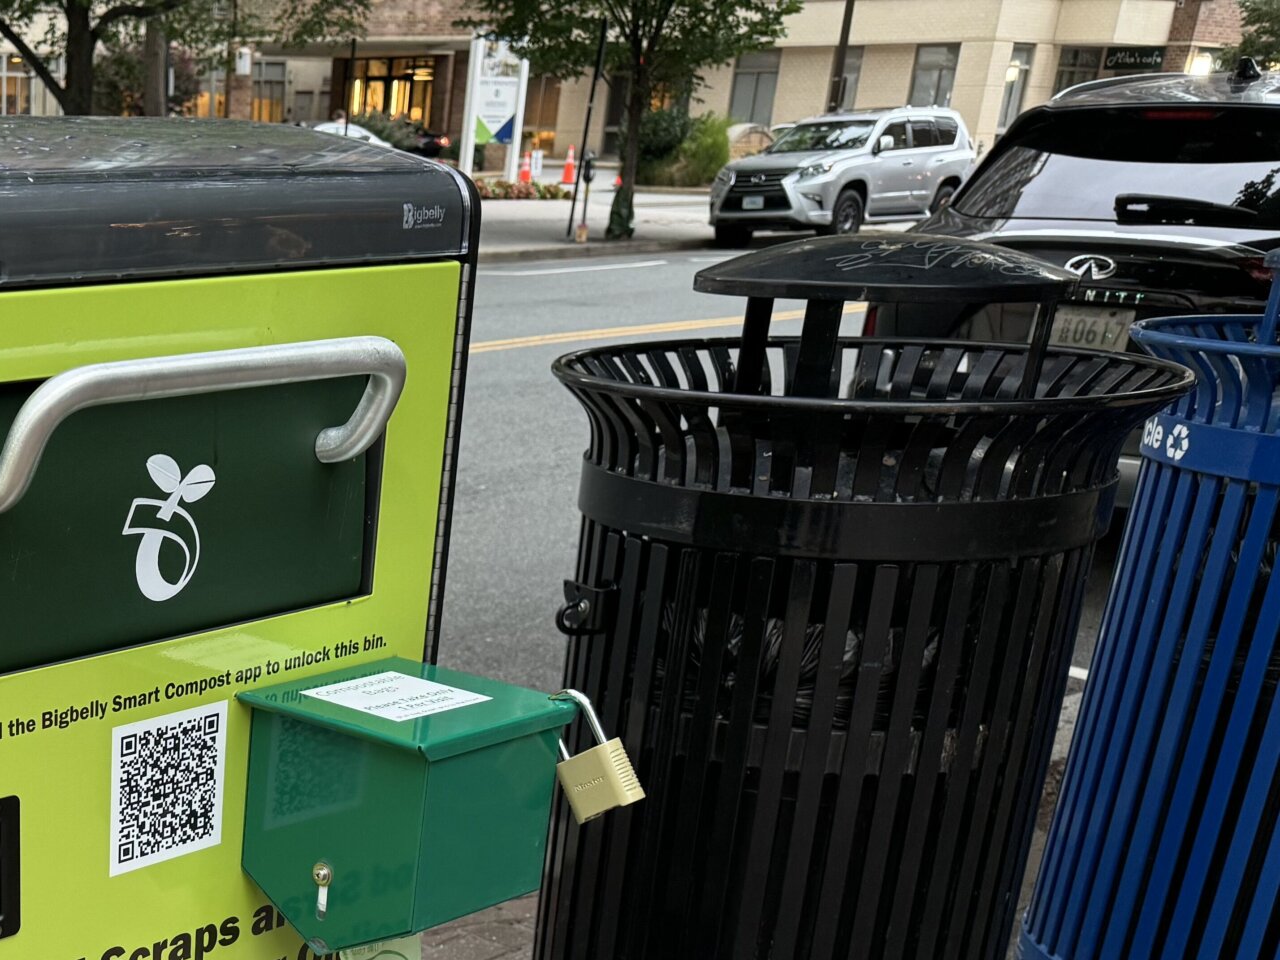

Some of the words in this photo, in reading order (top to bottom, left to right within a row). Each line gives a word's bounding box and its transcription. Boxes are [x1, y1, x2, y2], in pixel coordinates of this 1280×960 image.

[403, 203, 446, 229] Bigbelly
[1072, 289, 1144, 304] NITI
[8, 718, 36, 738] the
[41, 700, 108, 730] Bigbelly
[111, 686, 160, 713] Smart
[164, 669, 231, 700] Compost
[235, 666, 262, 690] app
[266, 659, 280, 676] to
[284, 646, 331, 671] unlock
[334, 639, 359, 664] this
[363, 633, 387, 653] bin.
